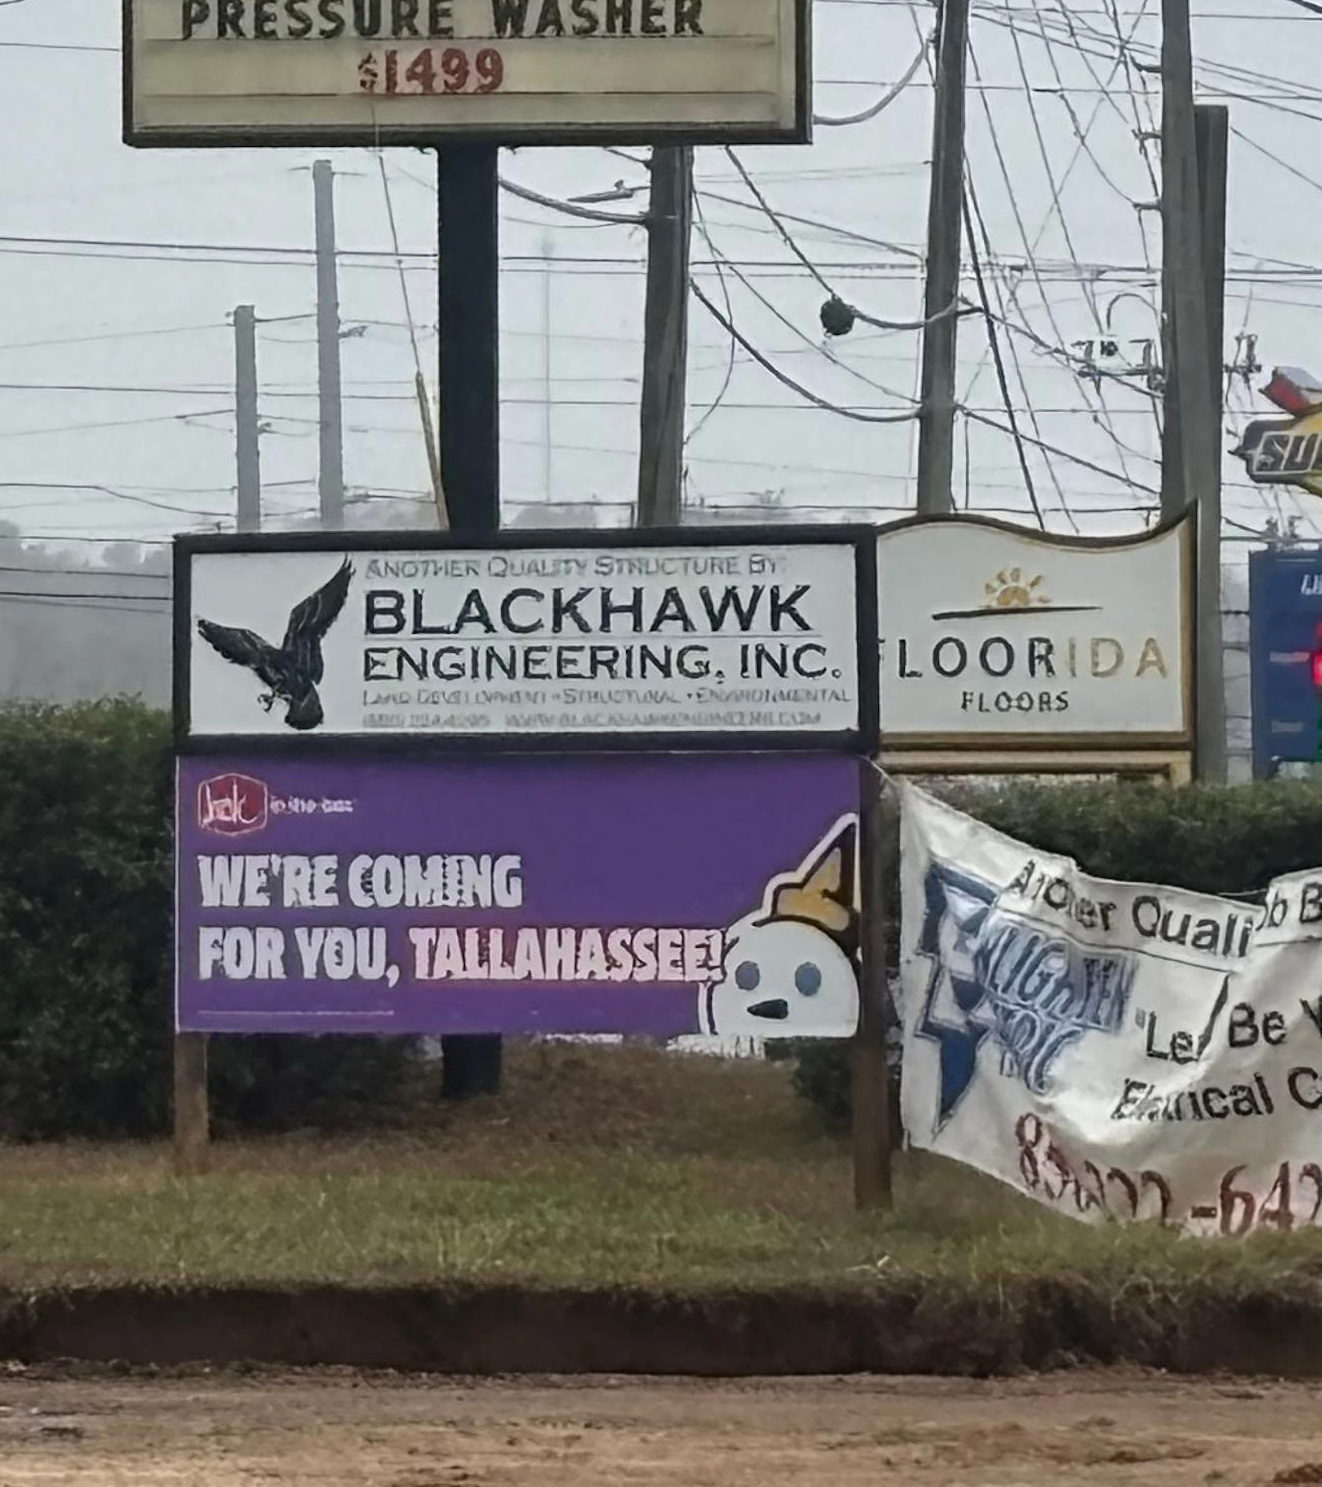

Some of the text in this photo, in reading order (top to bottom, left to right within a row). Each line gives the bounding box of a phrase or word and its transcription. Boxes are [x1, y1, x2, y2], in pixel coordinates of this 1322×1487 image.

[357, 47, 504, 94] $1499
[364, 558, 480, 579] ANOTHER
[487, 556, 590, 578] QUALITY
[594, 555, 742, 577] STRUCTURE
[364, 584, 814, 636] BLACKHAWK
[740, 642, 843, 680] INC.
[878, 635, 1169, 679] LOORIDA
[961, 690, 1070, 713] FLOORS
[197, 853, 523, 908] WE'RE COMING
[198, 926, 725, 989] FOR YOU, TALLAHASSEE!
[1228, 1002, 1287, 1047] Be
